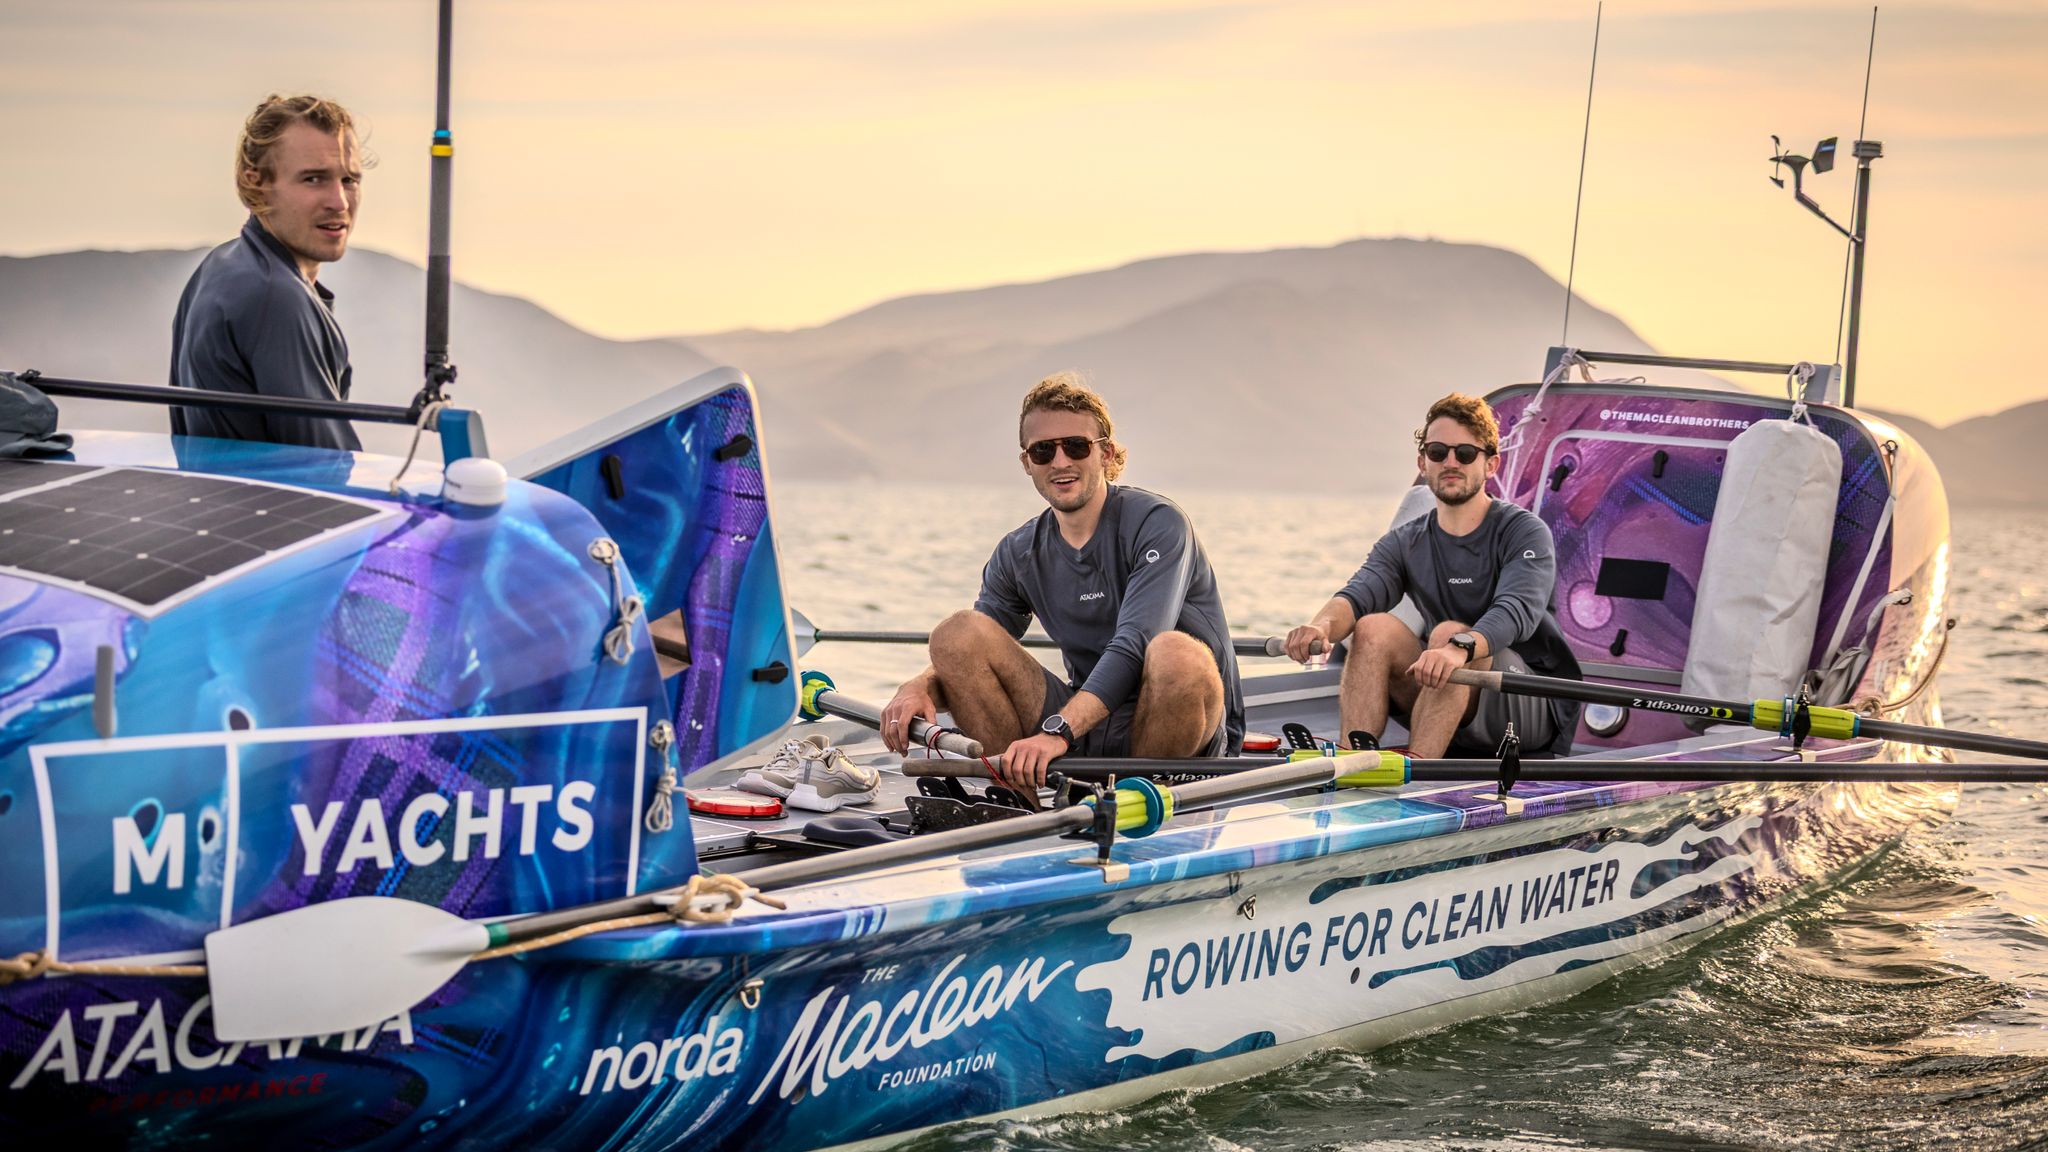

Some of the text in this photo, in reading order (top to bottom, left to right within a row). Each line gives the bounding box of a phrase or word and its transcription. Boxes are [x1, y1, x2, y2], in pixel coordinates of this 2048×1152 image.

[1600, 409, 1750, 429] @THEMACLEANBROTHERS
[1079, 591, 1105, 601] ATACAMA
[1633, 698, 1709, 715] concept 2
[1166, 773, 1222, 782] cept
[113, 780, 597, 895] M YACHTS
[1142, 858, 1620, 1002] ROWING FOR CLEAN WATER
[862, 963, 901, 983] THE
[579, 1015, 743, 1096] norda
[878, 1051, 998, 1091] FOUNDATION
